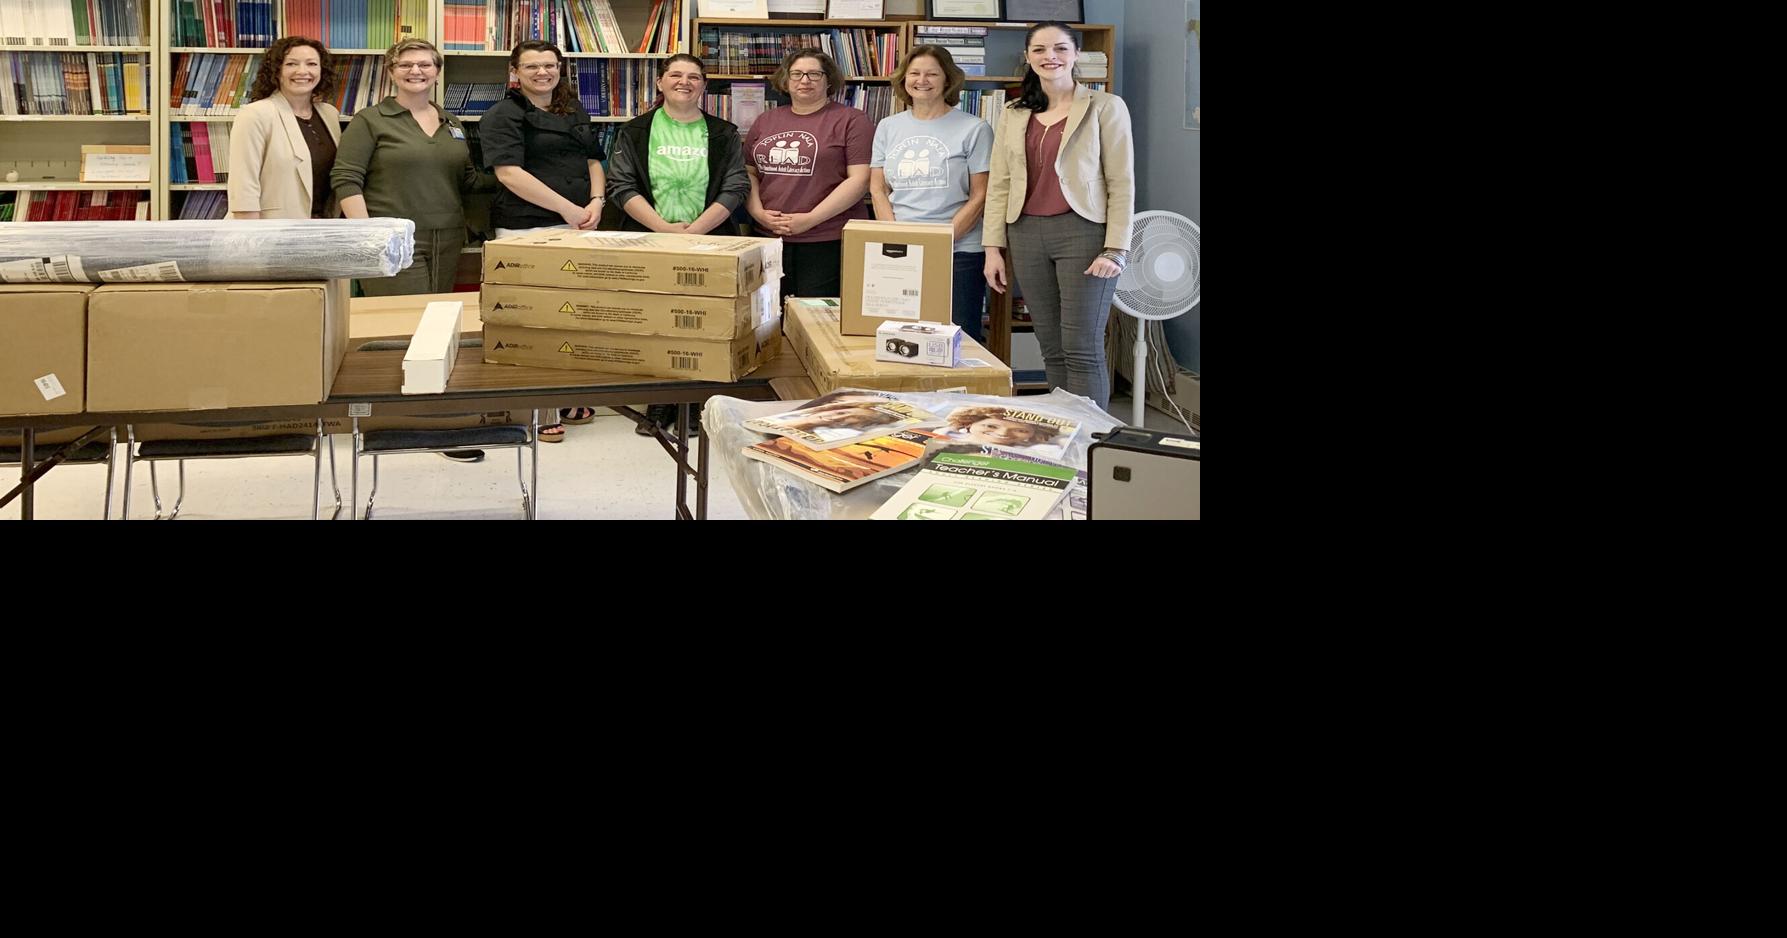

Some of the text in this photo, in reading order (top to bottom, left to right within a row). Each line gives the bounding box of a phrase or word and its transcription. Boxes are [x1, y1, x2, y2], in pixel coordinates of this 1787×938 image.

[761, 133, 794, 146] JOPLIN
[656, 145, 708, 158] amazo
[1003, 408, 1043, 422] STAND
[935, 463, 1000, 478] Teacher's
[1002, 472, 1060, 488] Manual
